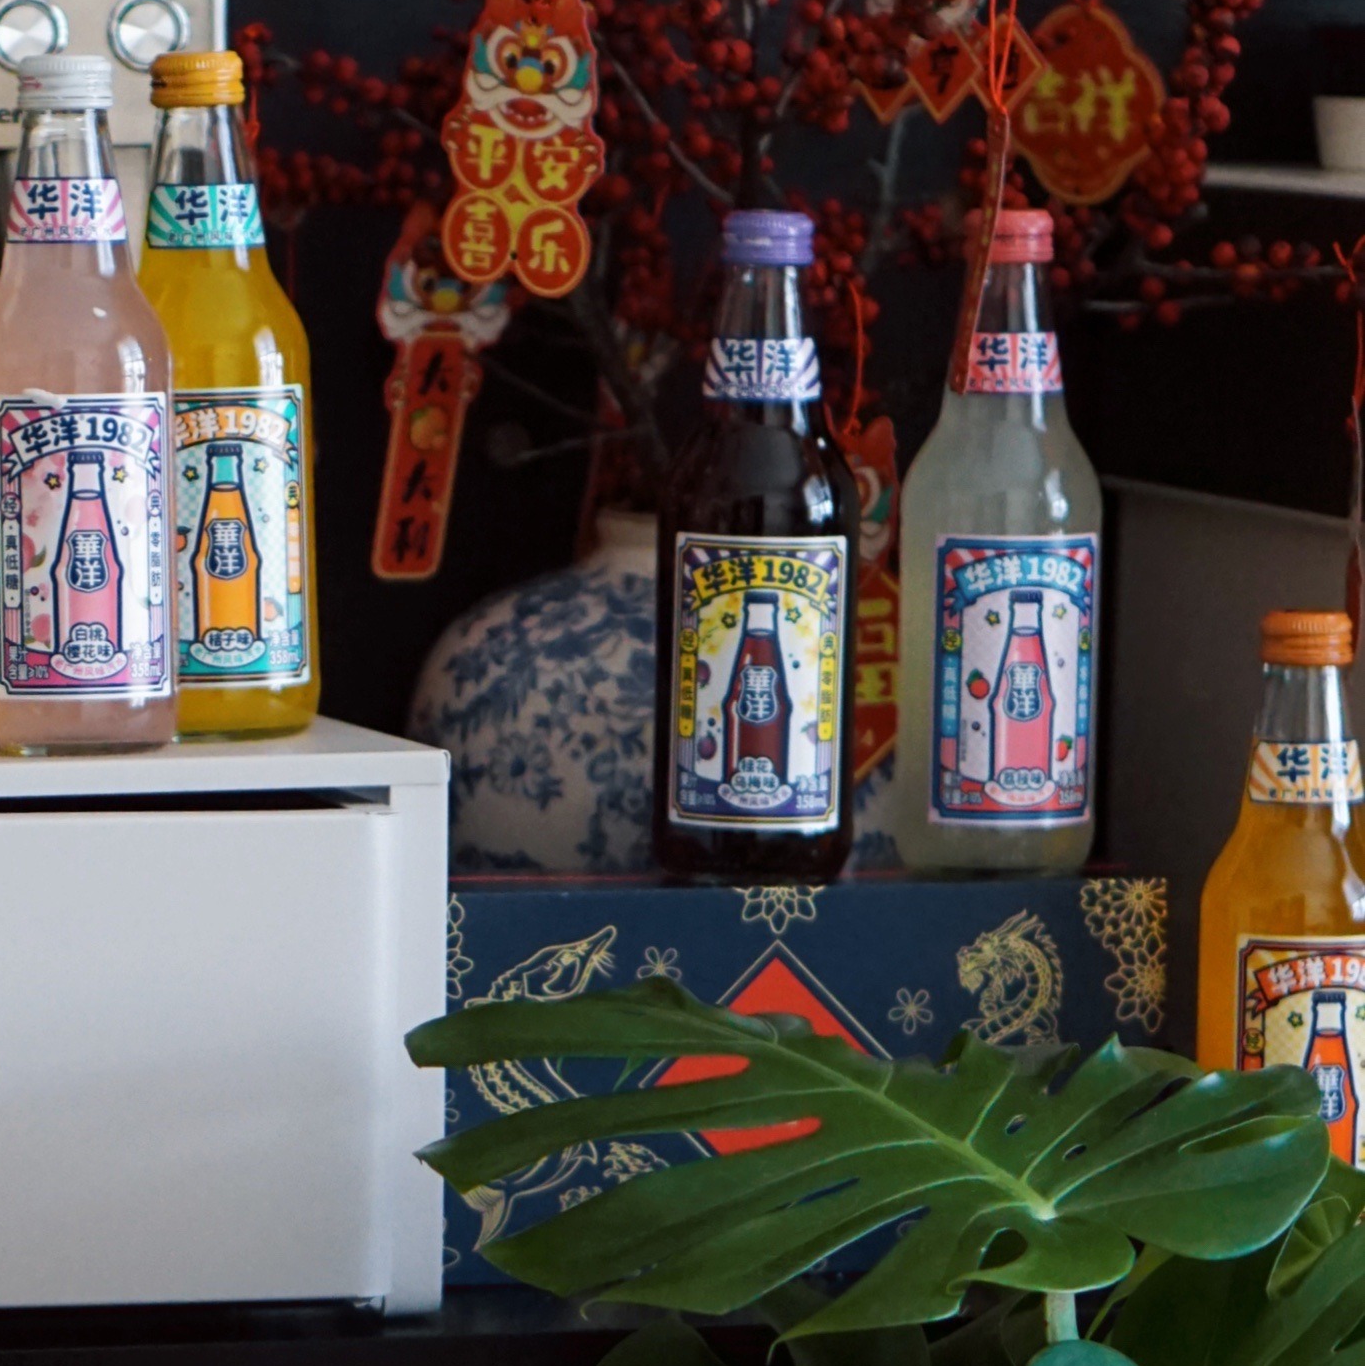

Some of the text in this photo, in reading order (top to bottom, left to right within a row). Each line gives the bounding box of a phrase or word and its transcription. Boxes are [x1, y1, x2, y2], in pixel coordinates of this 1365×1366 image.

[467, 124, 581, 192] 平安
[27, 184, 103, 220] 华洋
[175, 189, 249, 226] 华洋
[460, 200, 570, 275] 喜乐
[723, 343, 796, 378] 华洋
[976, 337, 1049, 372] 华洋
[74, 534, 102, 586] 華洋
[214, 522, 241, 574] 華洋
